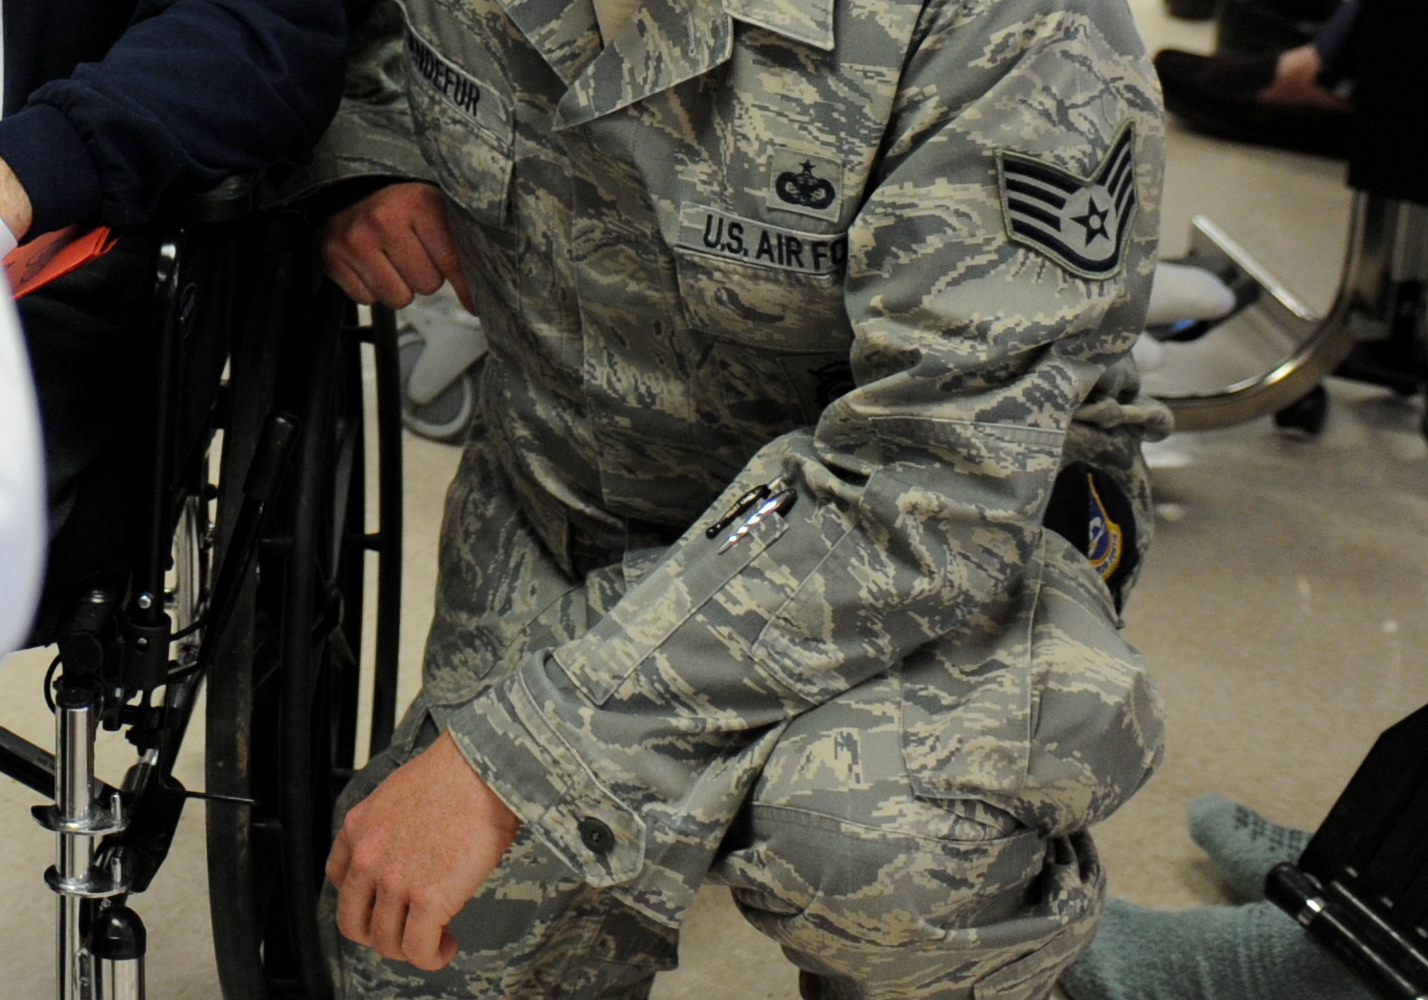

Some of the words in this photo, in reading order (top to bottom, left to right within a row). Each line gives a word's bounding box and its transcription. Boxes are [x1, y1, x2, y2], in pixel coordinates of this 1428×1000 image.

[703, 213, 749, 257] U.S.
[755, 229, 805, 269] AIR
[810, 238, 848, 272] FO
